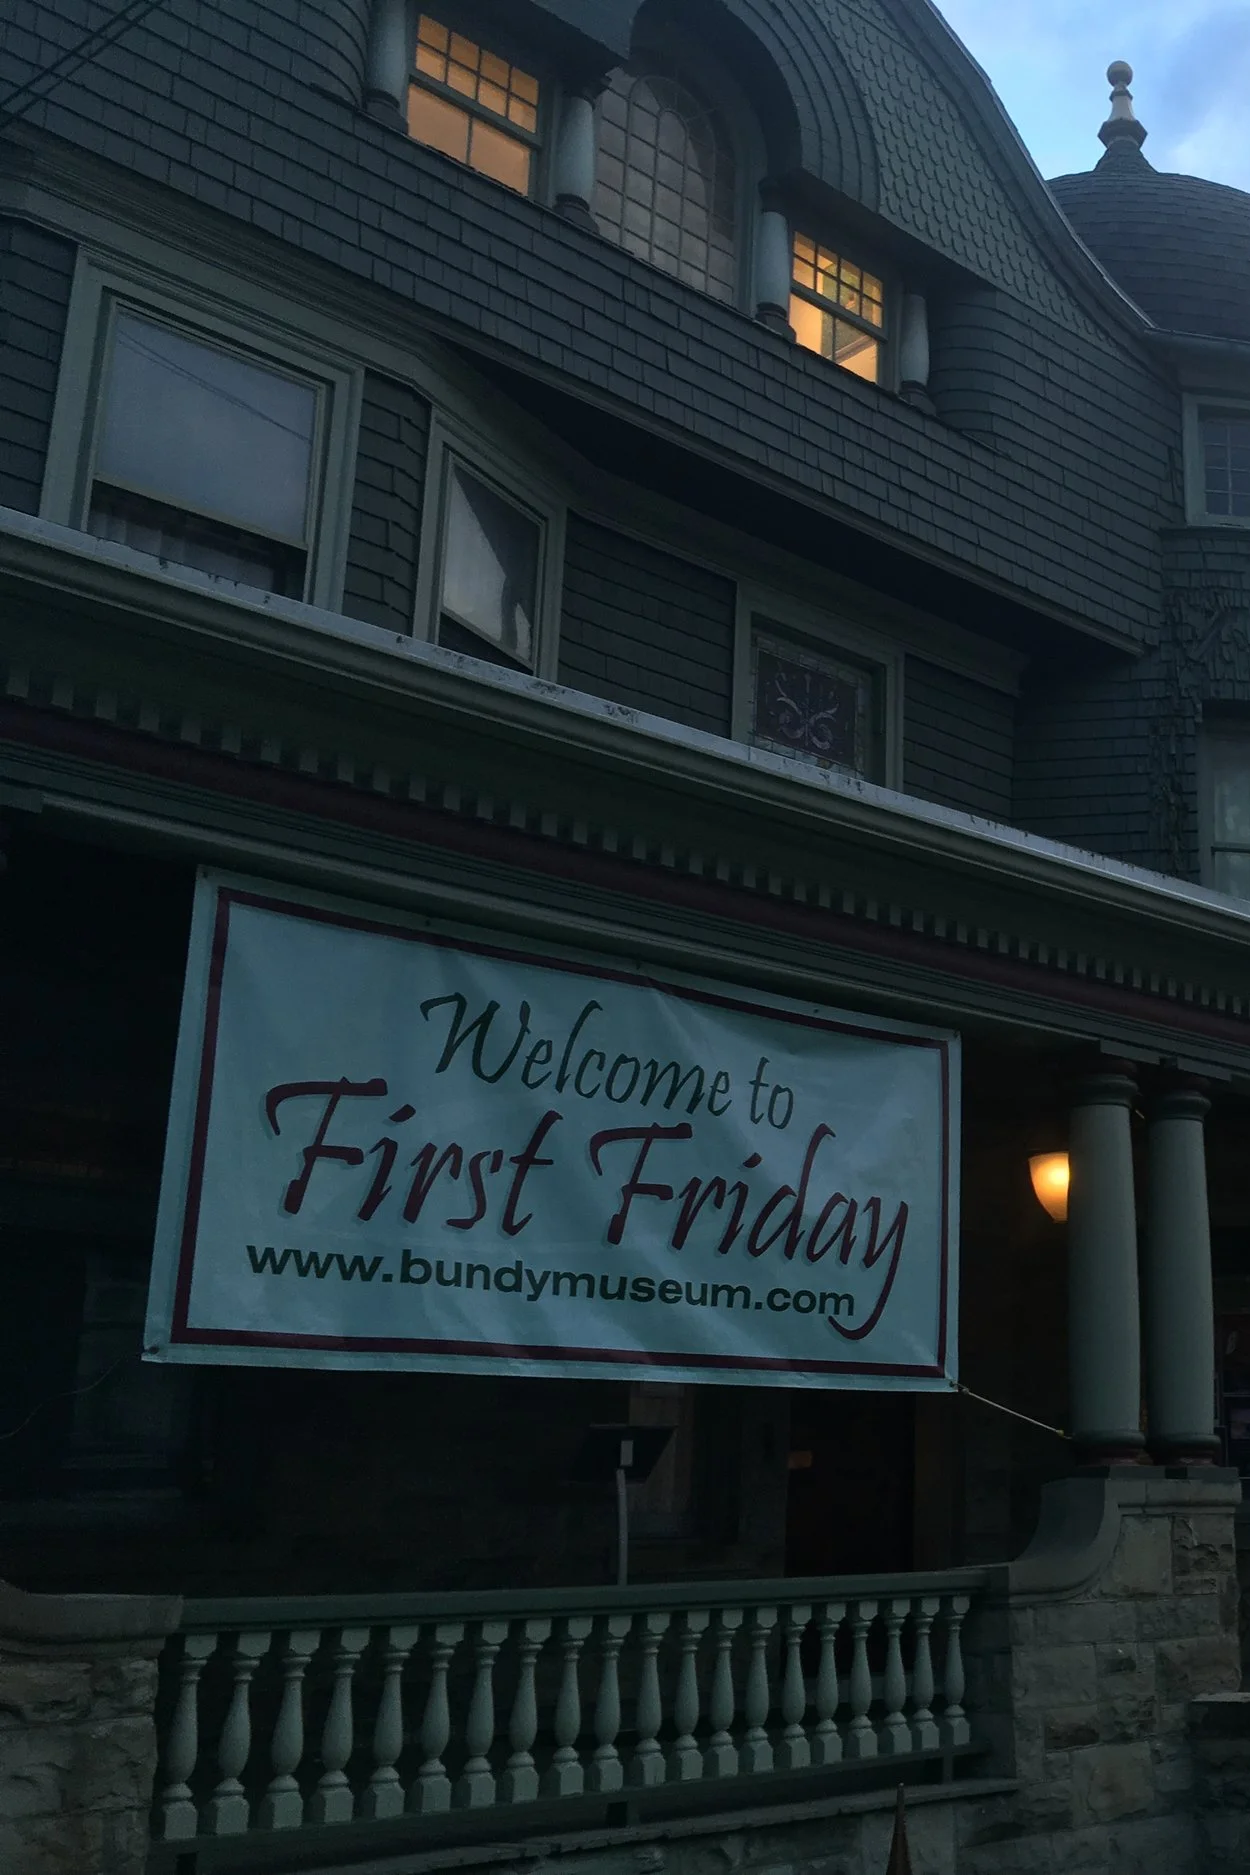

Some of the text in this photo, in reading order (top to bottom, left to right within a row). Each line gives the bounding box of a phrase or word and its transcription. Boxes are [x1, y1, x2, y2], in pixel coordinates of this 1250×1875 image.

[421, 992, 794, 1130] Welcome to
[264, 1077, 909, 1340] First Friday
[245, 1244, 855, 1317] www.bundymuseum.com
